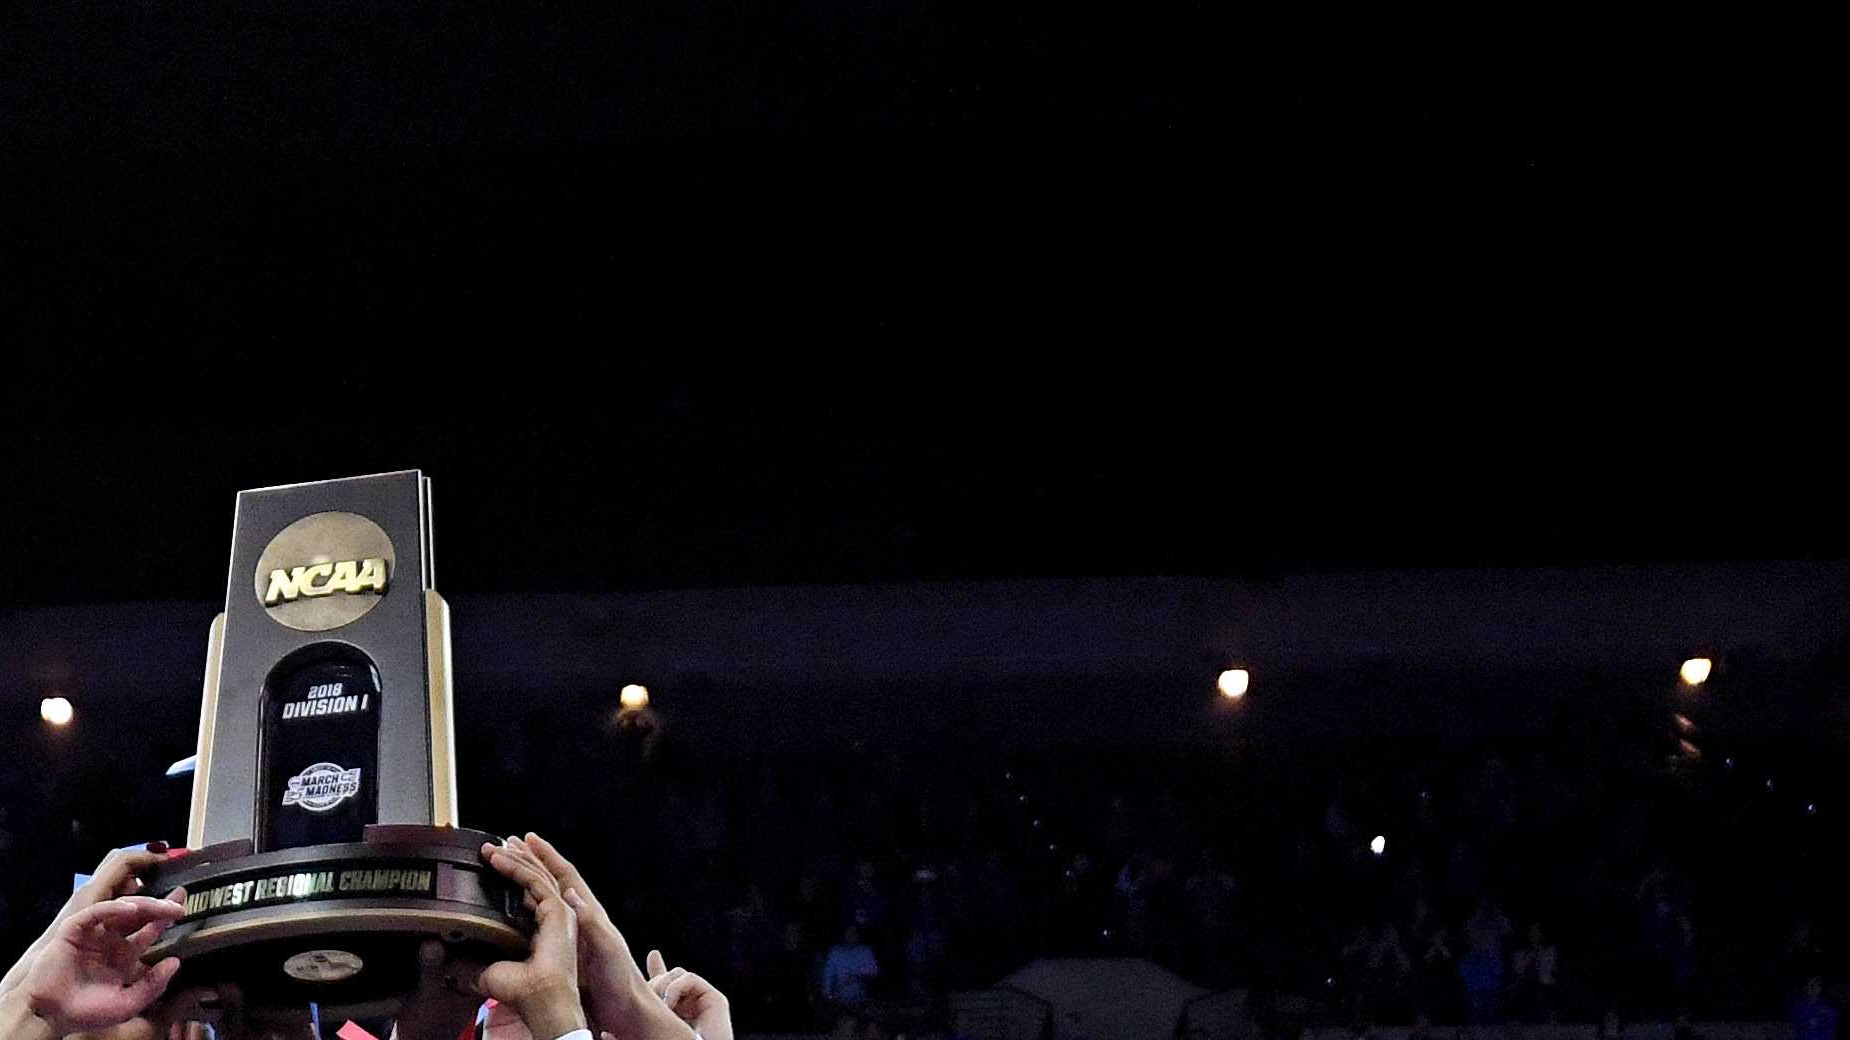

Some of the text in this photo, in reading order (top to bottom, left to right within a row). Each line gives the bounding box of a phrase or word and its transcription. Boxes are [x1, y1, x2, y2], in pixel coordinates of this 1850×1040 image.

[265, 559, 387, 604] NCAA
[308, 683, 343, 699] 2018
[282, 694, 368, 719] DIVISION I
[302, 774, 340, 786] MARCH
[305, 782, 356, 796] MADNESS
[255, 871, 334, 900] REGIONAL
[339, 869, 431, 891] CHAMPION
